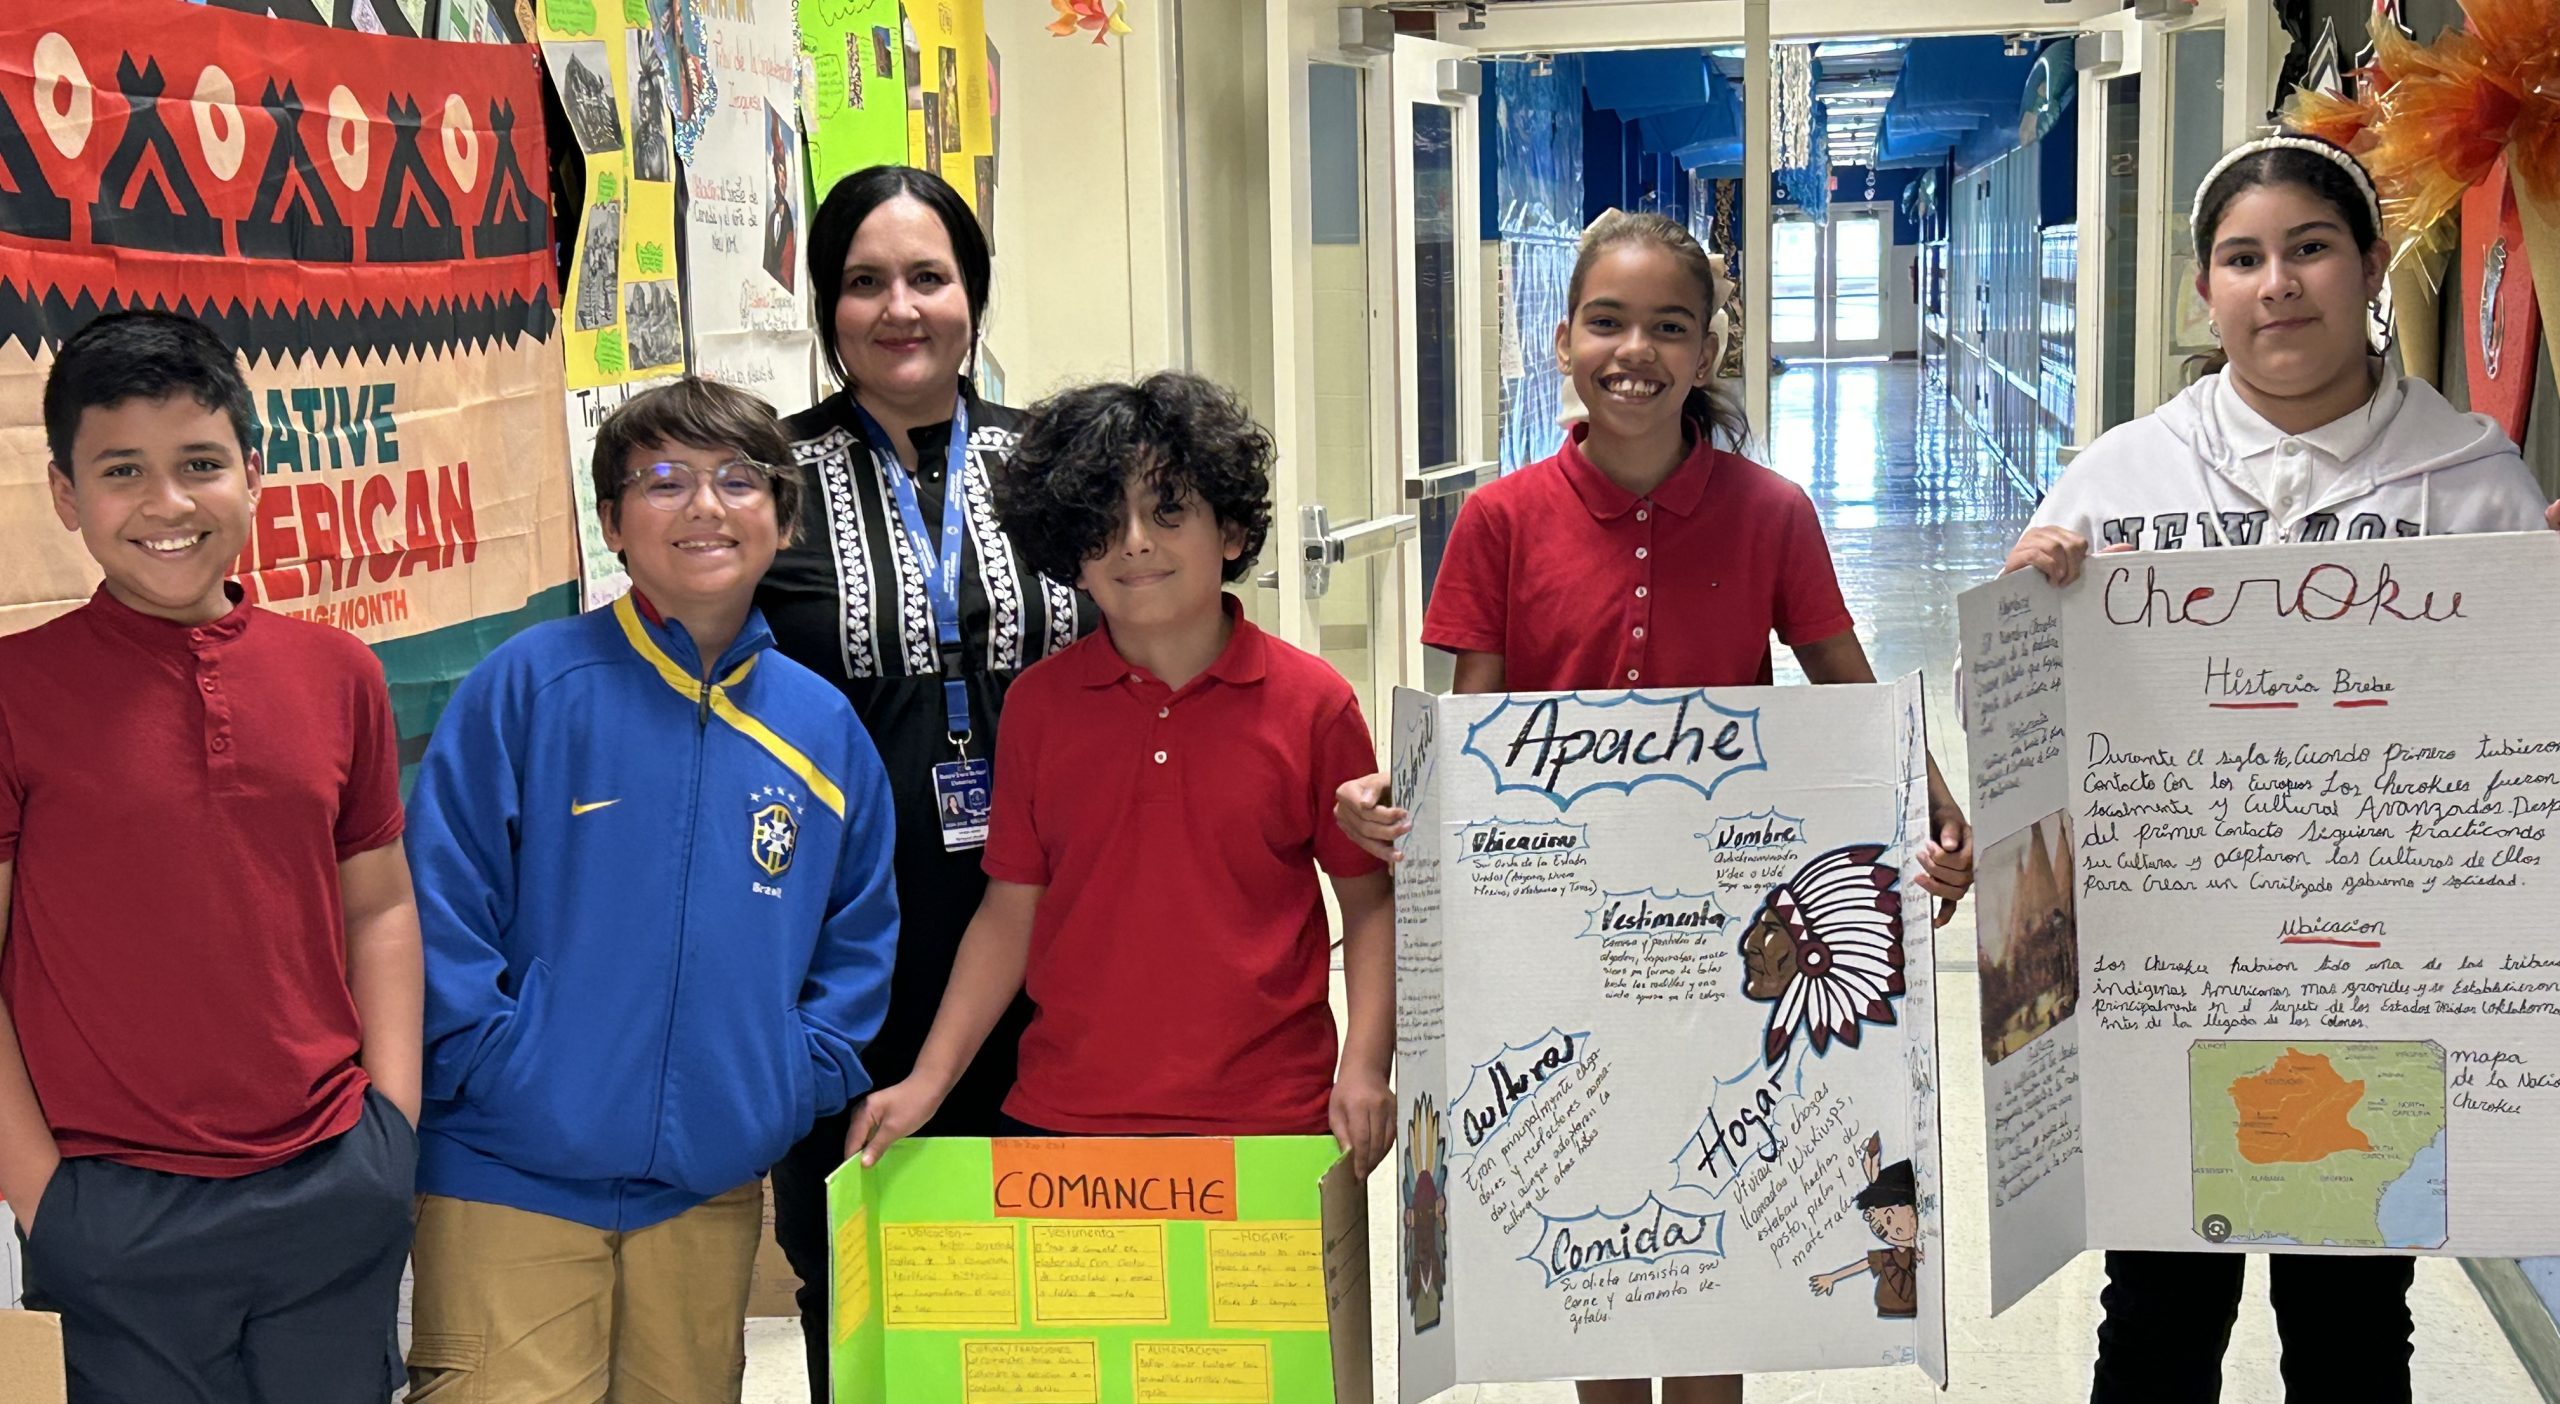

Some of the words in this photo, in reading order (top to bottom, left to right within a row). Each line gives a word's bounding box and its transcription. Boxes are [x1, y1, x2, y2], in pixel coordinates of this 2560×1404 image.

[339, 589, 408, 631] MONTH
[2205, 656, 2320, 698] Historia
[1505, 697, 1743, 793] Apache
[2087, 732, 2177, 769] Durante
[1716, 818, 1796, 850] Nombre
[1602, 899, 1727, 931] Vestimenta
[994, 1171, 1225, 1215] COMANCHE
[1552, 1205, 1707, 1276] Comida
